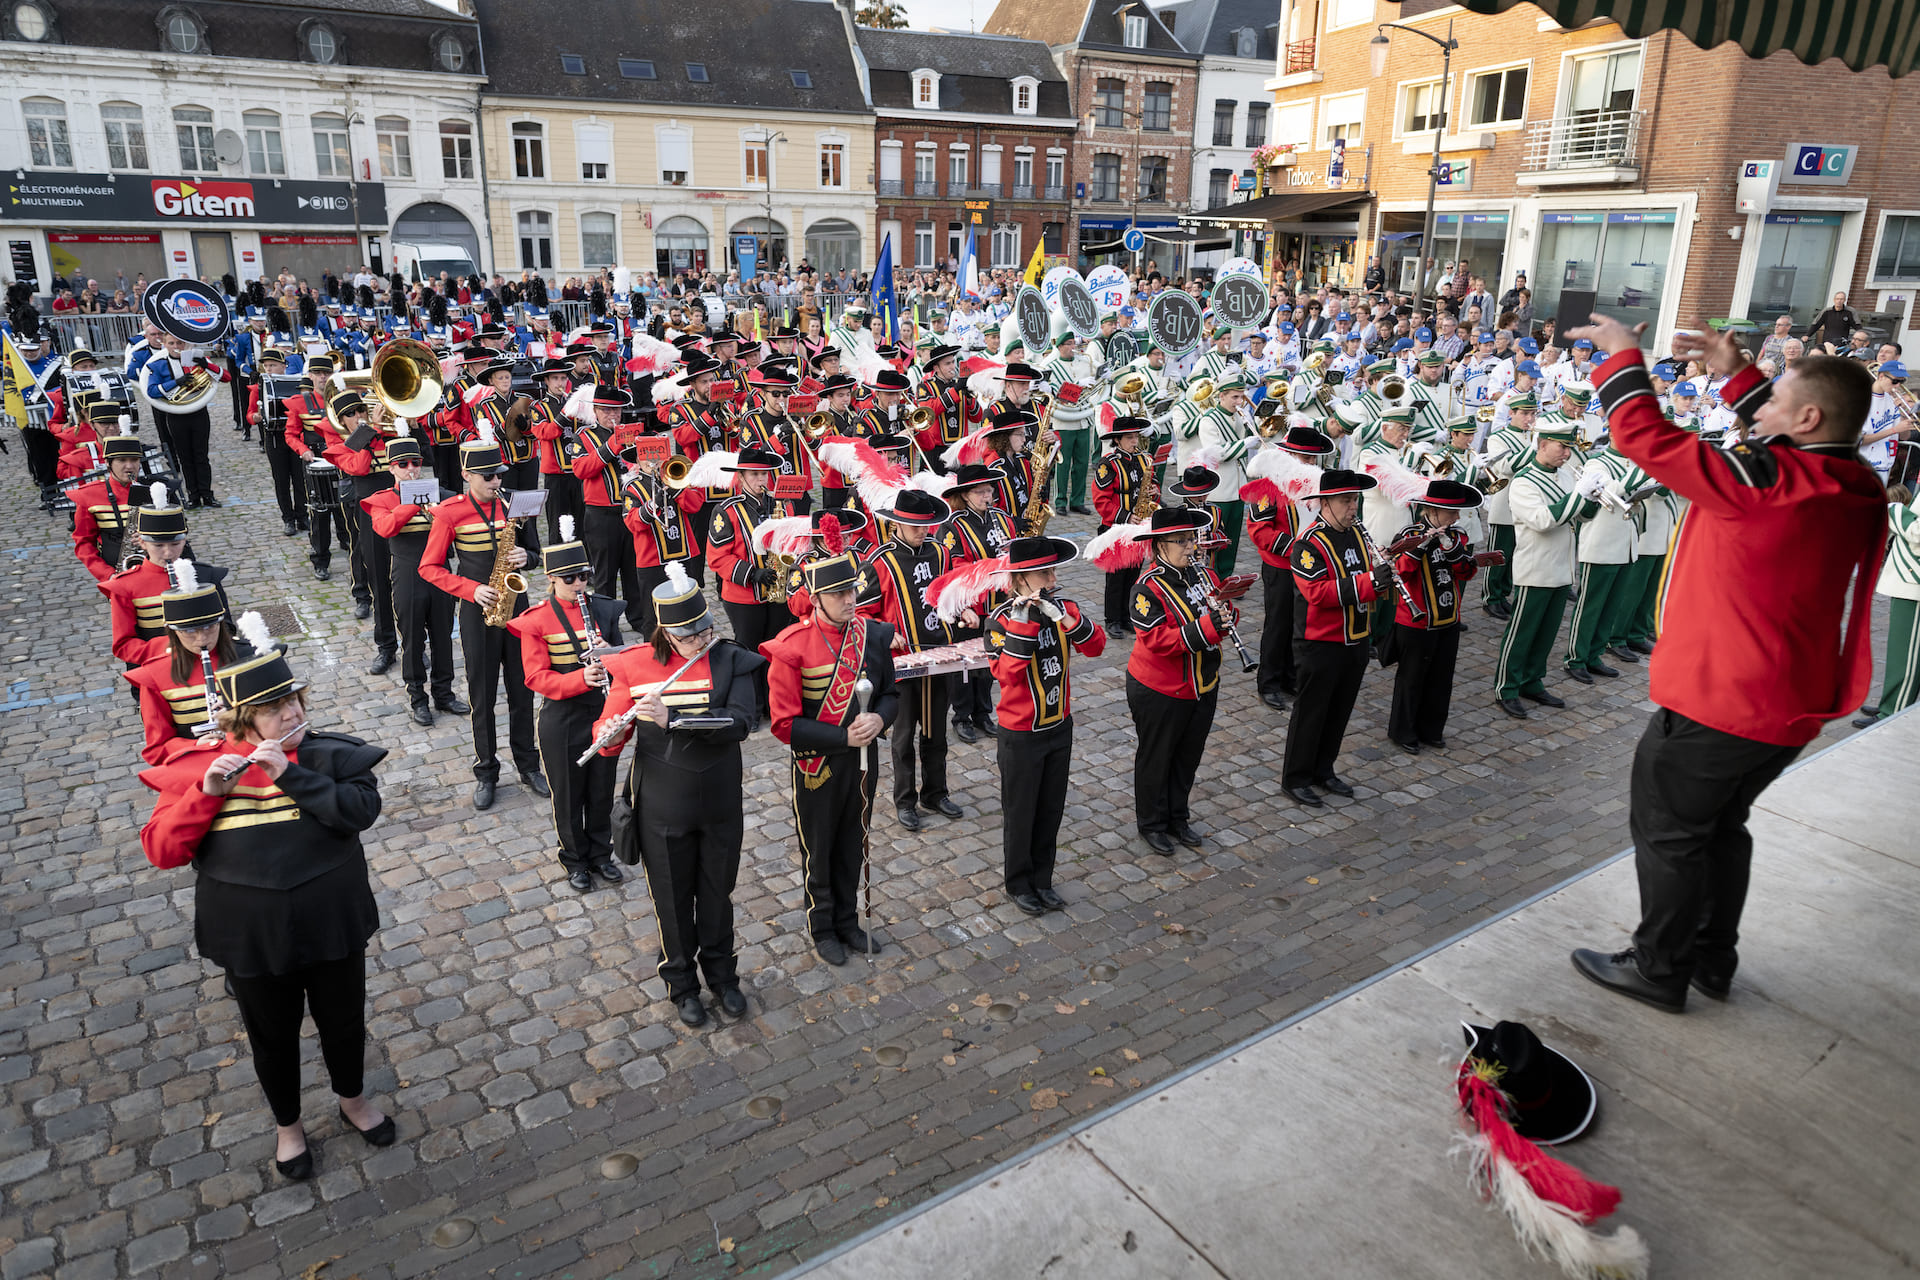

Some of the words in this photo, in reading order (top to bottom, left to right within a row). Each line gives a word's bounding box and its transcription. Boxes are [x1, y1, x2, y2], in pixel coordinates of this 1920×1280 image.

[1801, 152, 1842, 171] CIC
[1286, 166, 1315, 186] Tabac
[1325, 164, 1349, 185] Lo
[1747, 165, 1768, 175] CIC
[19, 184, 115, 195] ÉLECTROMÉNAGER
[22, 198, 84, 206] MULTIMEDIA
[154, 183, 255, 216] Gitem
